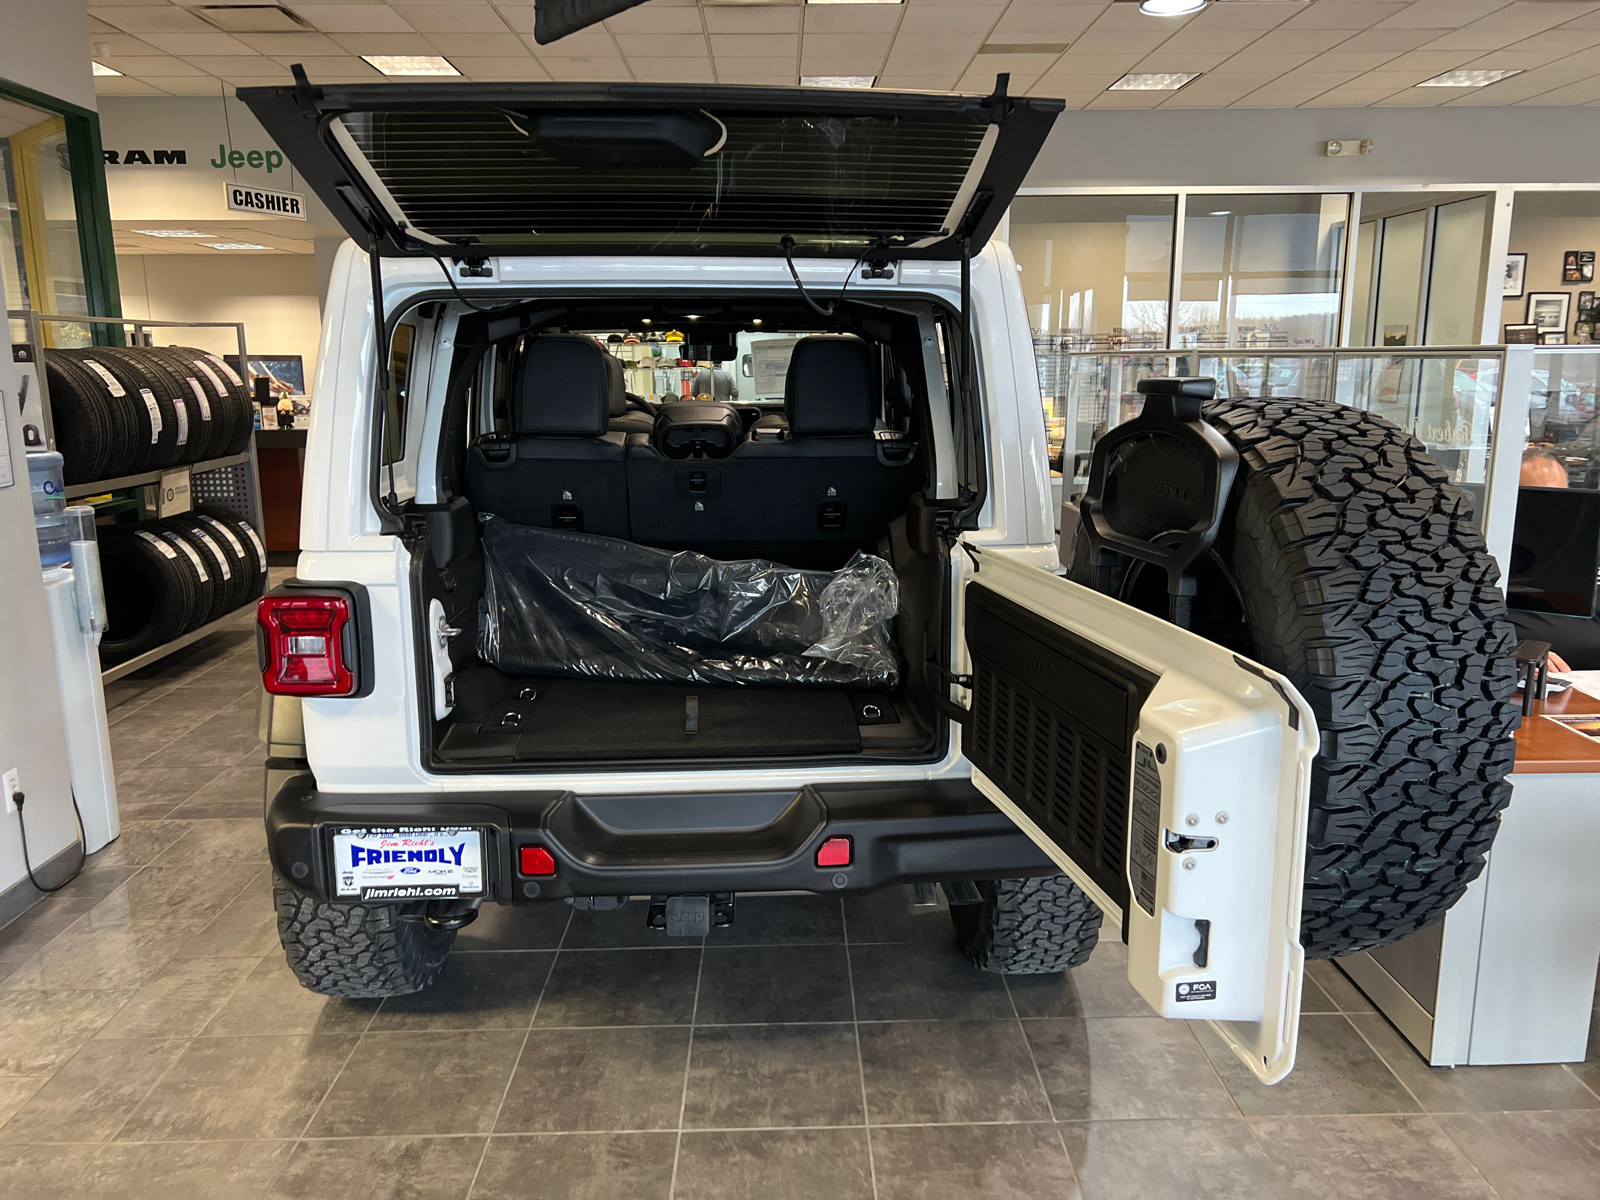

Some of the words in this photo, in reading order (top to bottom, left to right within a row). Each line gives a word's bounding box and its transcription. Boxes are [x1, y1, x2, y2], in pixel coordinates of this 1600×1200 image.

[103, 150, 187, 165] RAM
[210, 144, 283, 173] Jeep
[232, 189, 300, 214] CASHIER
[1136, 756, 1157, 773] JL
[340, 827, 367, 835] Get
[370, 826, 395, 834] the
[398, 825, 436, 833] Riehl
[379, 839, 399, 849] Jim
[401, 838, 435, 847] Riehl's
[350, 842, 466, 868] FRIENDLY
[364, 886, 456, 900] jimriehl.com
[672, 911, 705, 923] Jeep
[1192, 983, 1212, 991] FCA
